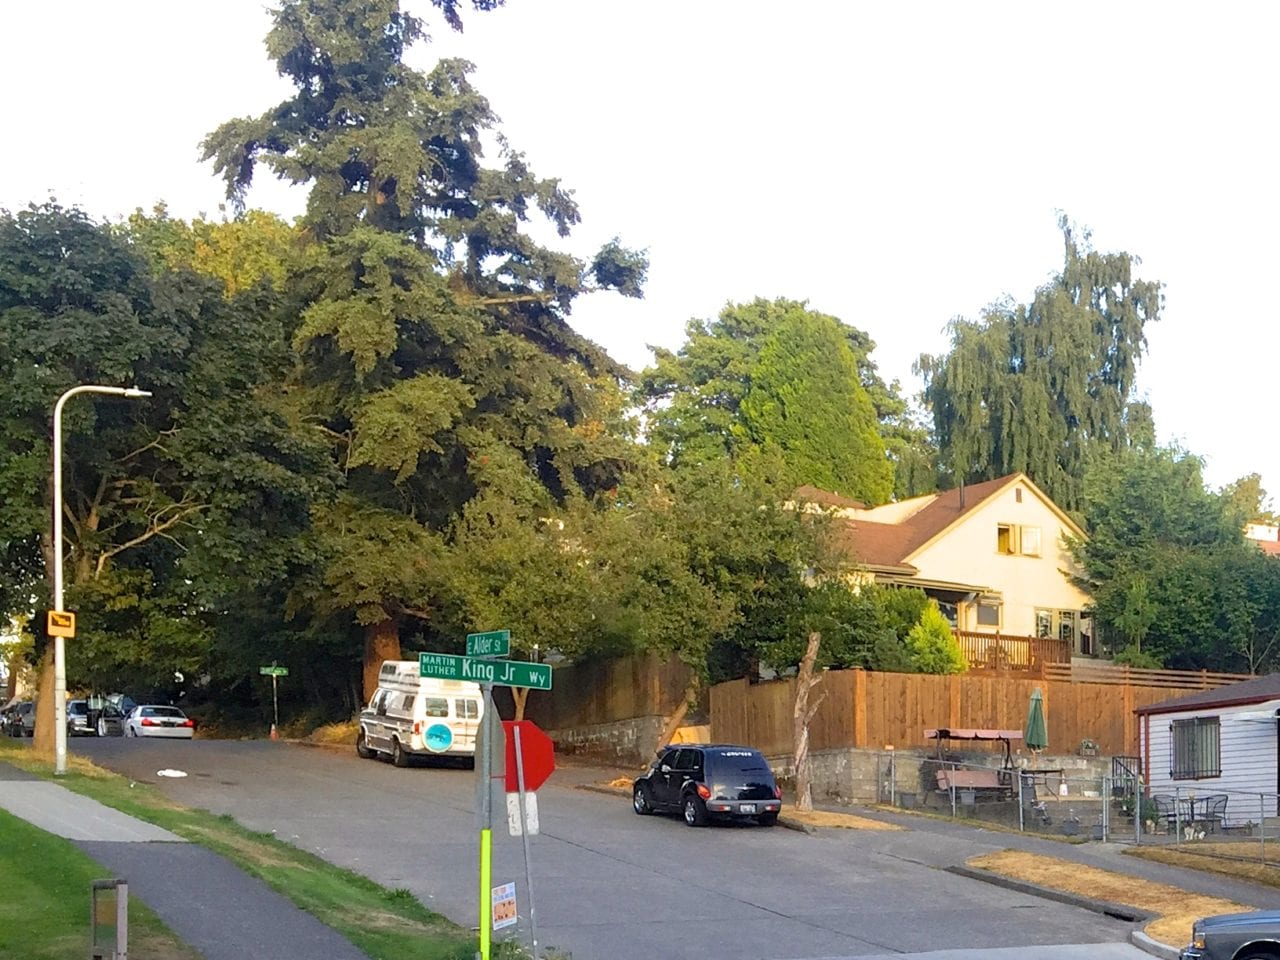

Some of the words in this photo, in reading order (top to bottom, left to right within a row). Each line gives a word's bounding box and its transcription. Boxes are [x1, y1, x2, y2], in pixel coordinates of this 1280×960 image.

[473, 637, 493, 654] Alder
[422, 655, 456, 666] MARTIN
[422, 664, 456, 676] LUTHER
[462, 659, 494, 682] King
[500, 663, 516, 681] Jr
[529, 671, 546, 686] Wy
